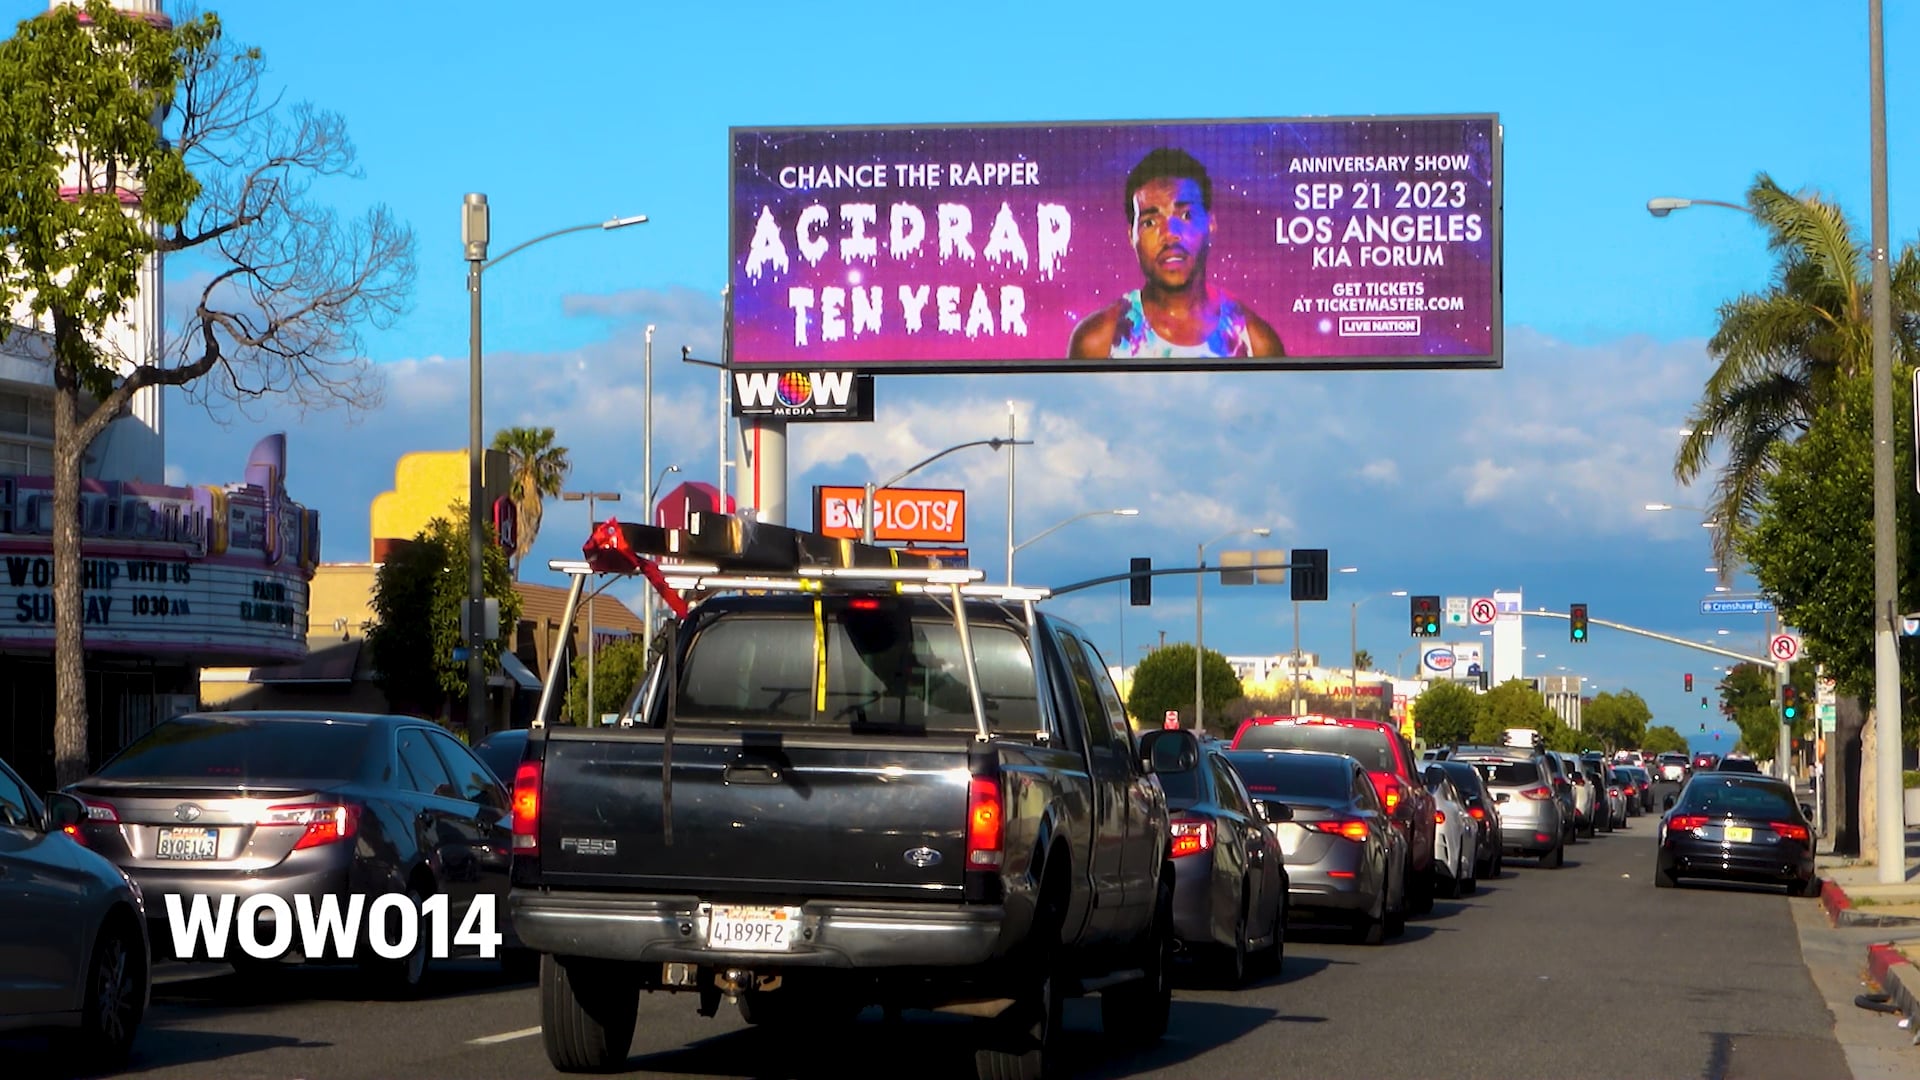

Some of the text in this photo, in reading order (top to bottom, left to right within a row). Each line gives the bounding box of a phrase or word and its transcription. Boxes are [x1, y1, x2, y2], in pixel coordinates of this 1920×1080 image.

[778, 161, 1040, 188] CHANCE THE RAPPER
[1289, 155, 1470, 173] ANNIVERSARY SHOW
[1294, 181, 1466, 210] SEP 21 2023
[1276, 214, 1483, 244] LOS ANGELES
[1313, 245, 1444, 268] KIA FORUM
[1333, 282, 1425, 297] GET TICKETS
[789, 283, 1028, 347] TEN YEAR
[1293, 297, 1465, 313] AT TICKETMASTER.COM
[1344, 318, 1416, 332] LIVE NATION
[773, 408, 814, 416] MEDIA
[825, 497, 960, 533] BIG LOTS!
[6, 556, 191, 589] WOHIP WITH US
[16, 593, 112, 625] SUAY
[132, 595, 169, 617] 1030
[714, 923, 783, 943] 41899F2
